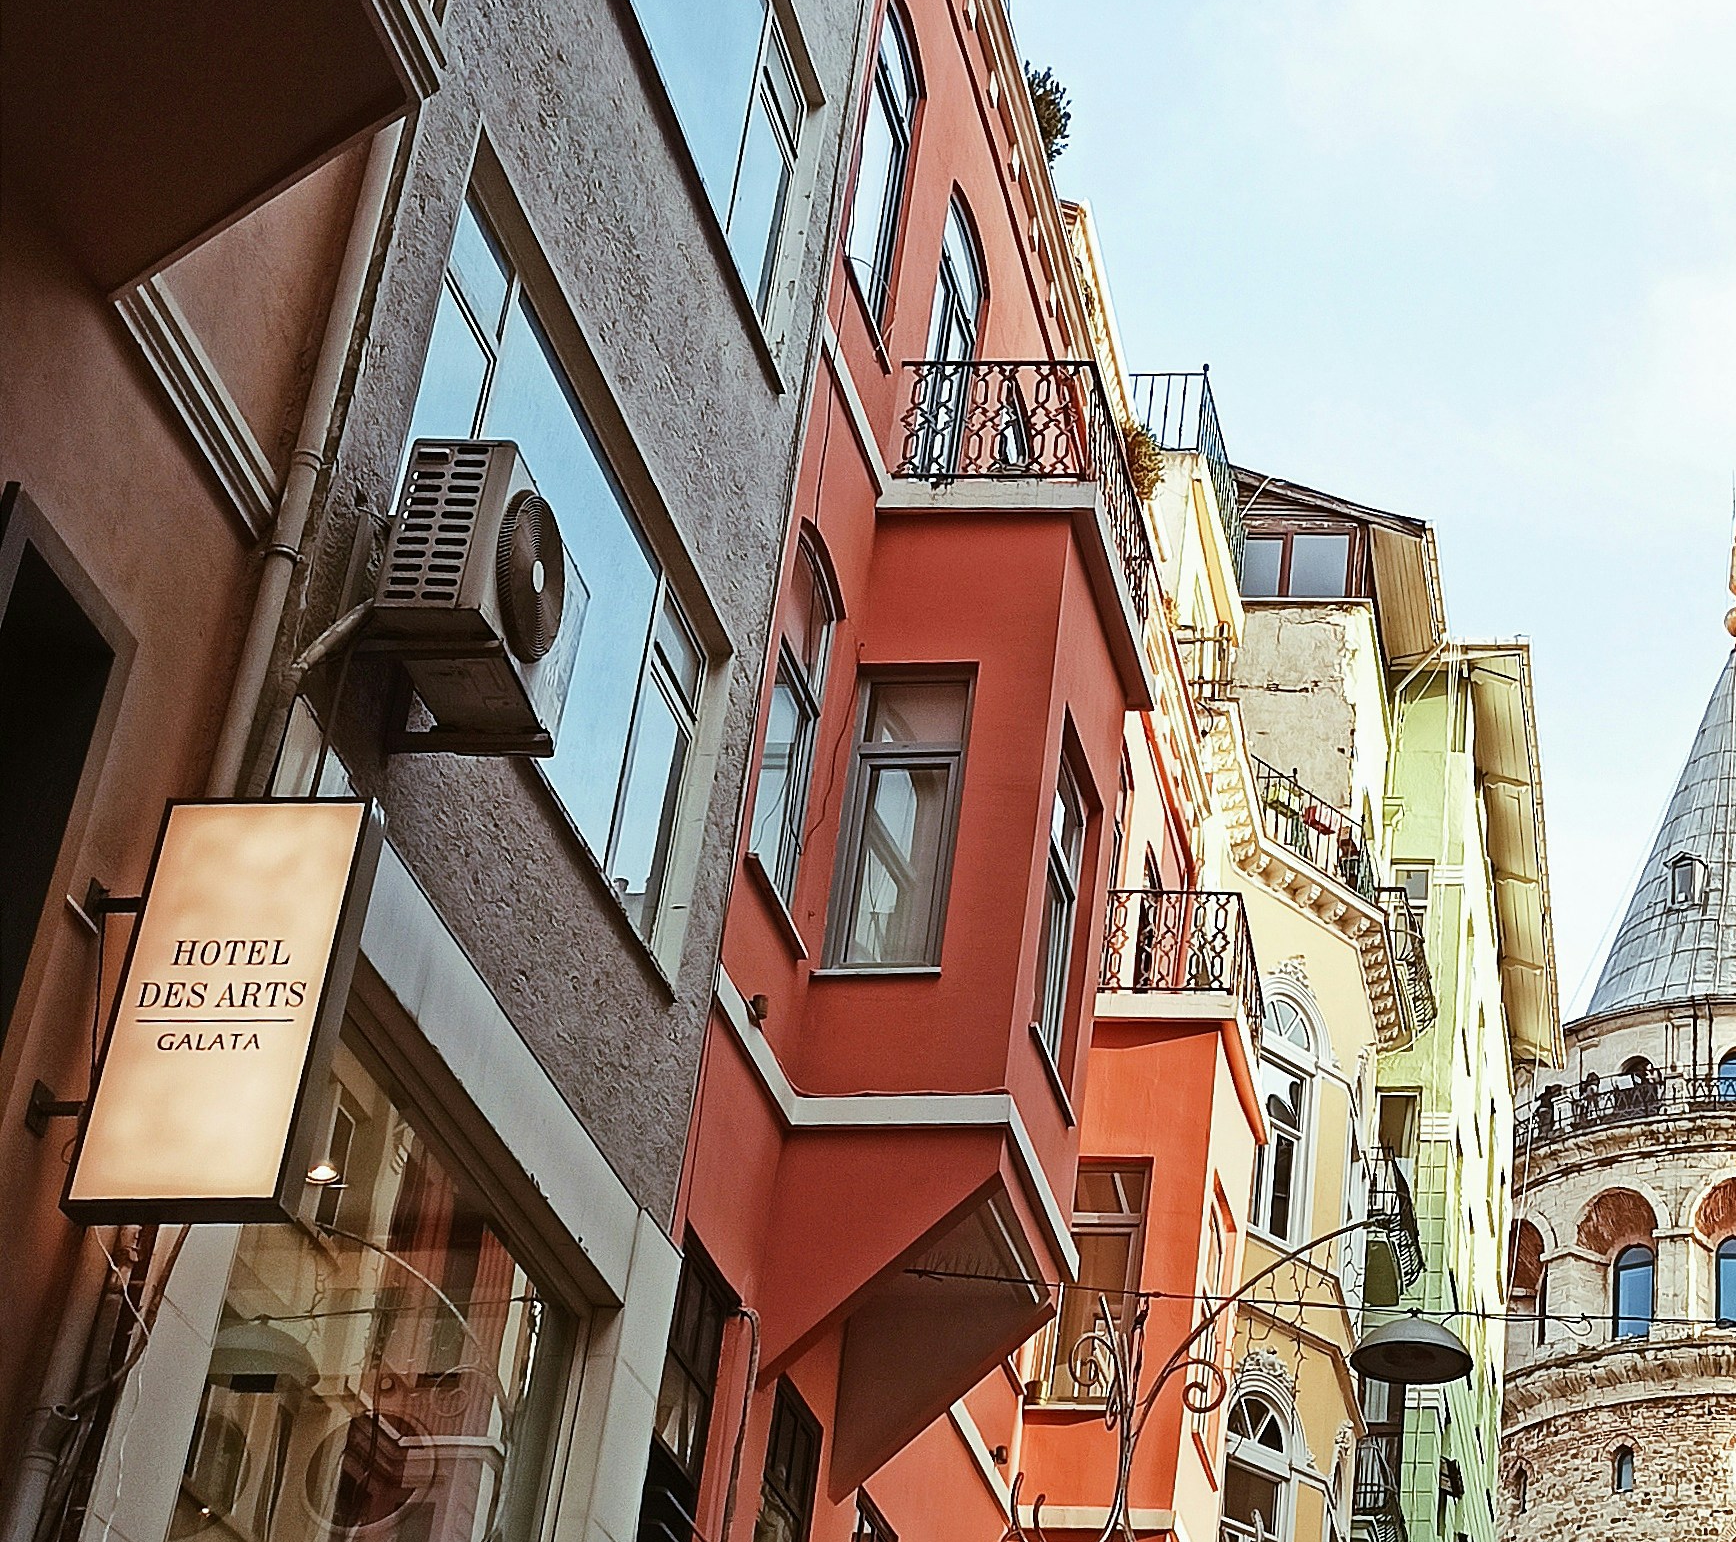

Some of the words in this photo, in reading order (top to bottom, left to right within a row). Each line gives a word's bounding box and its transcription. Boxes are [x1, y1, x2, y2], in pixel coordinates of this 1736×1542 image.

[171, 939, 292, 966] HOTEL
[135, 981, 209, 1008] DES
[214, 981, 307, 1008] ARTS
[156, 1032, 260, 1051] GALATA
